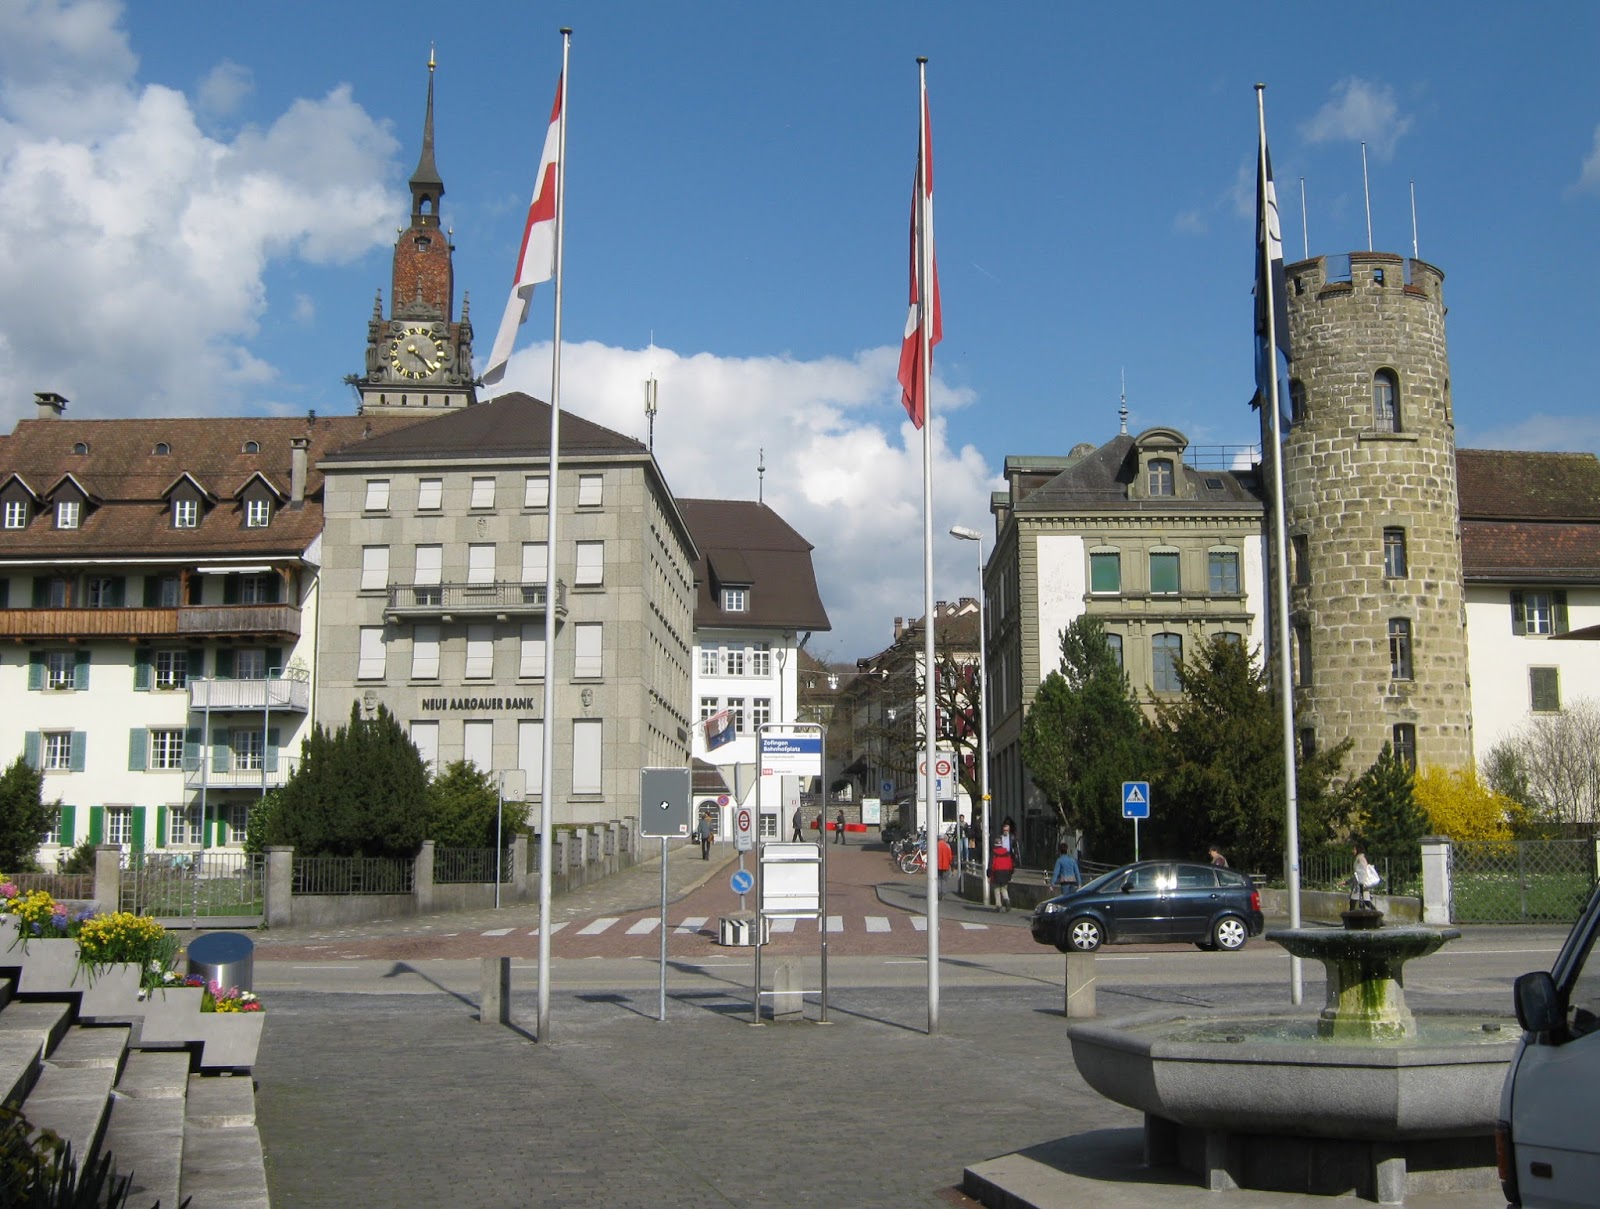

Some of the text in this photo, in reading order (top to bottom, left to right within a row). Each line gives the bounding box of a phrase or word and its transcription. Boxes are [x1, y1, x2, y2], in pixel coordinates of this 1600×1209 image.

[422, 697, 534, 711] NEUE AARGAUER BANK
